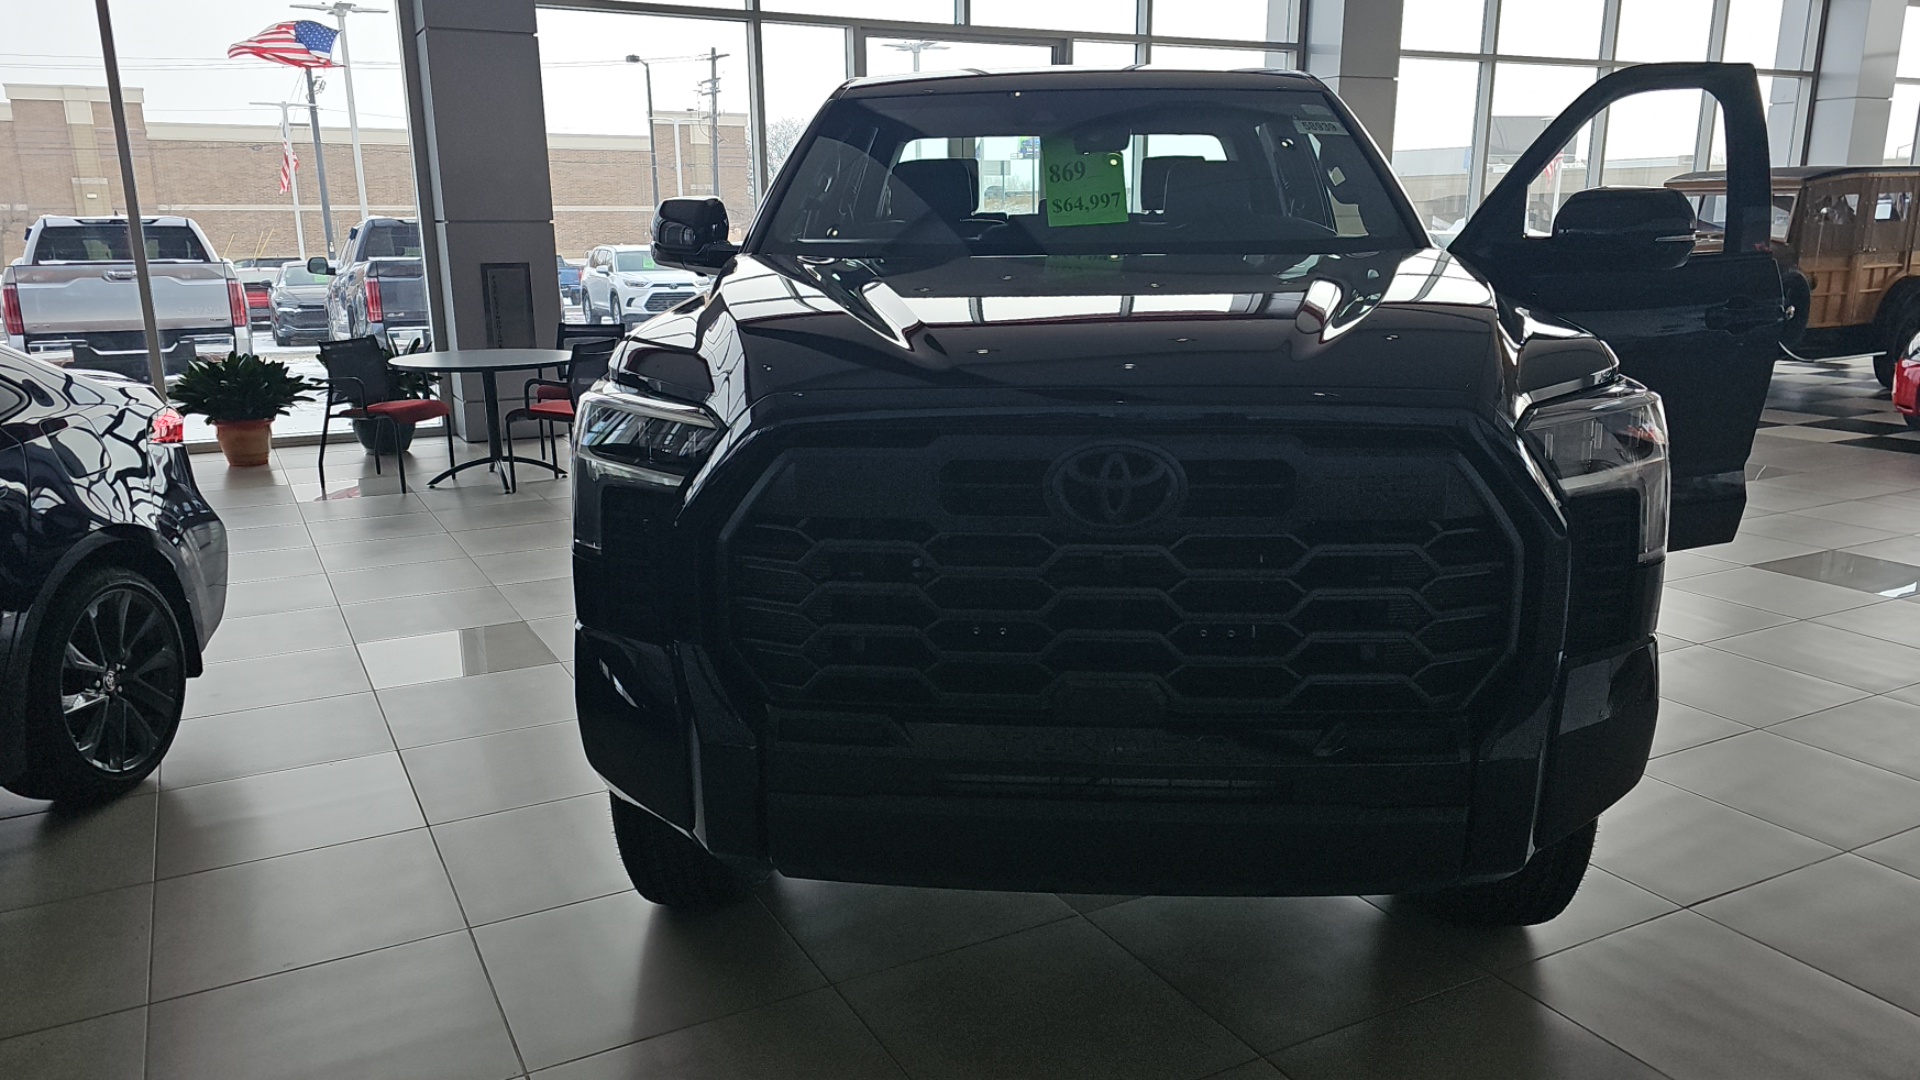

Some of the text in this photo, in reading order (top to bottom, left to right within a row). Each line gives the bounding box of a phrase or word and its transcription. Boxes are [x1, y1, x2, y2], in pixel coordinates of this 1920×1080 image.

[1302, 121, 1337, 132] 58939
[1049, 161, 1086, 183] 869
[1052, 192, 1120, 213] $64,997
